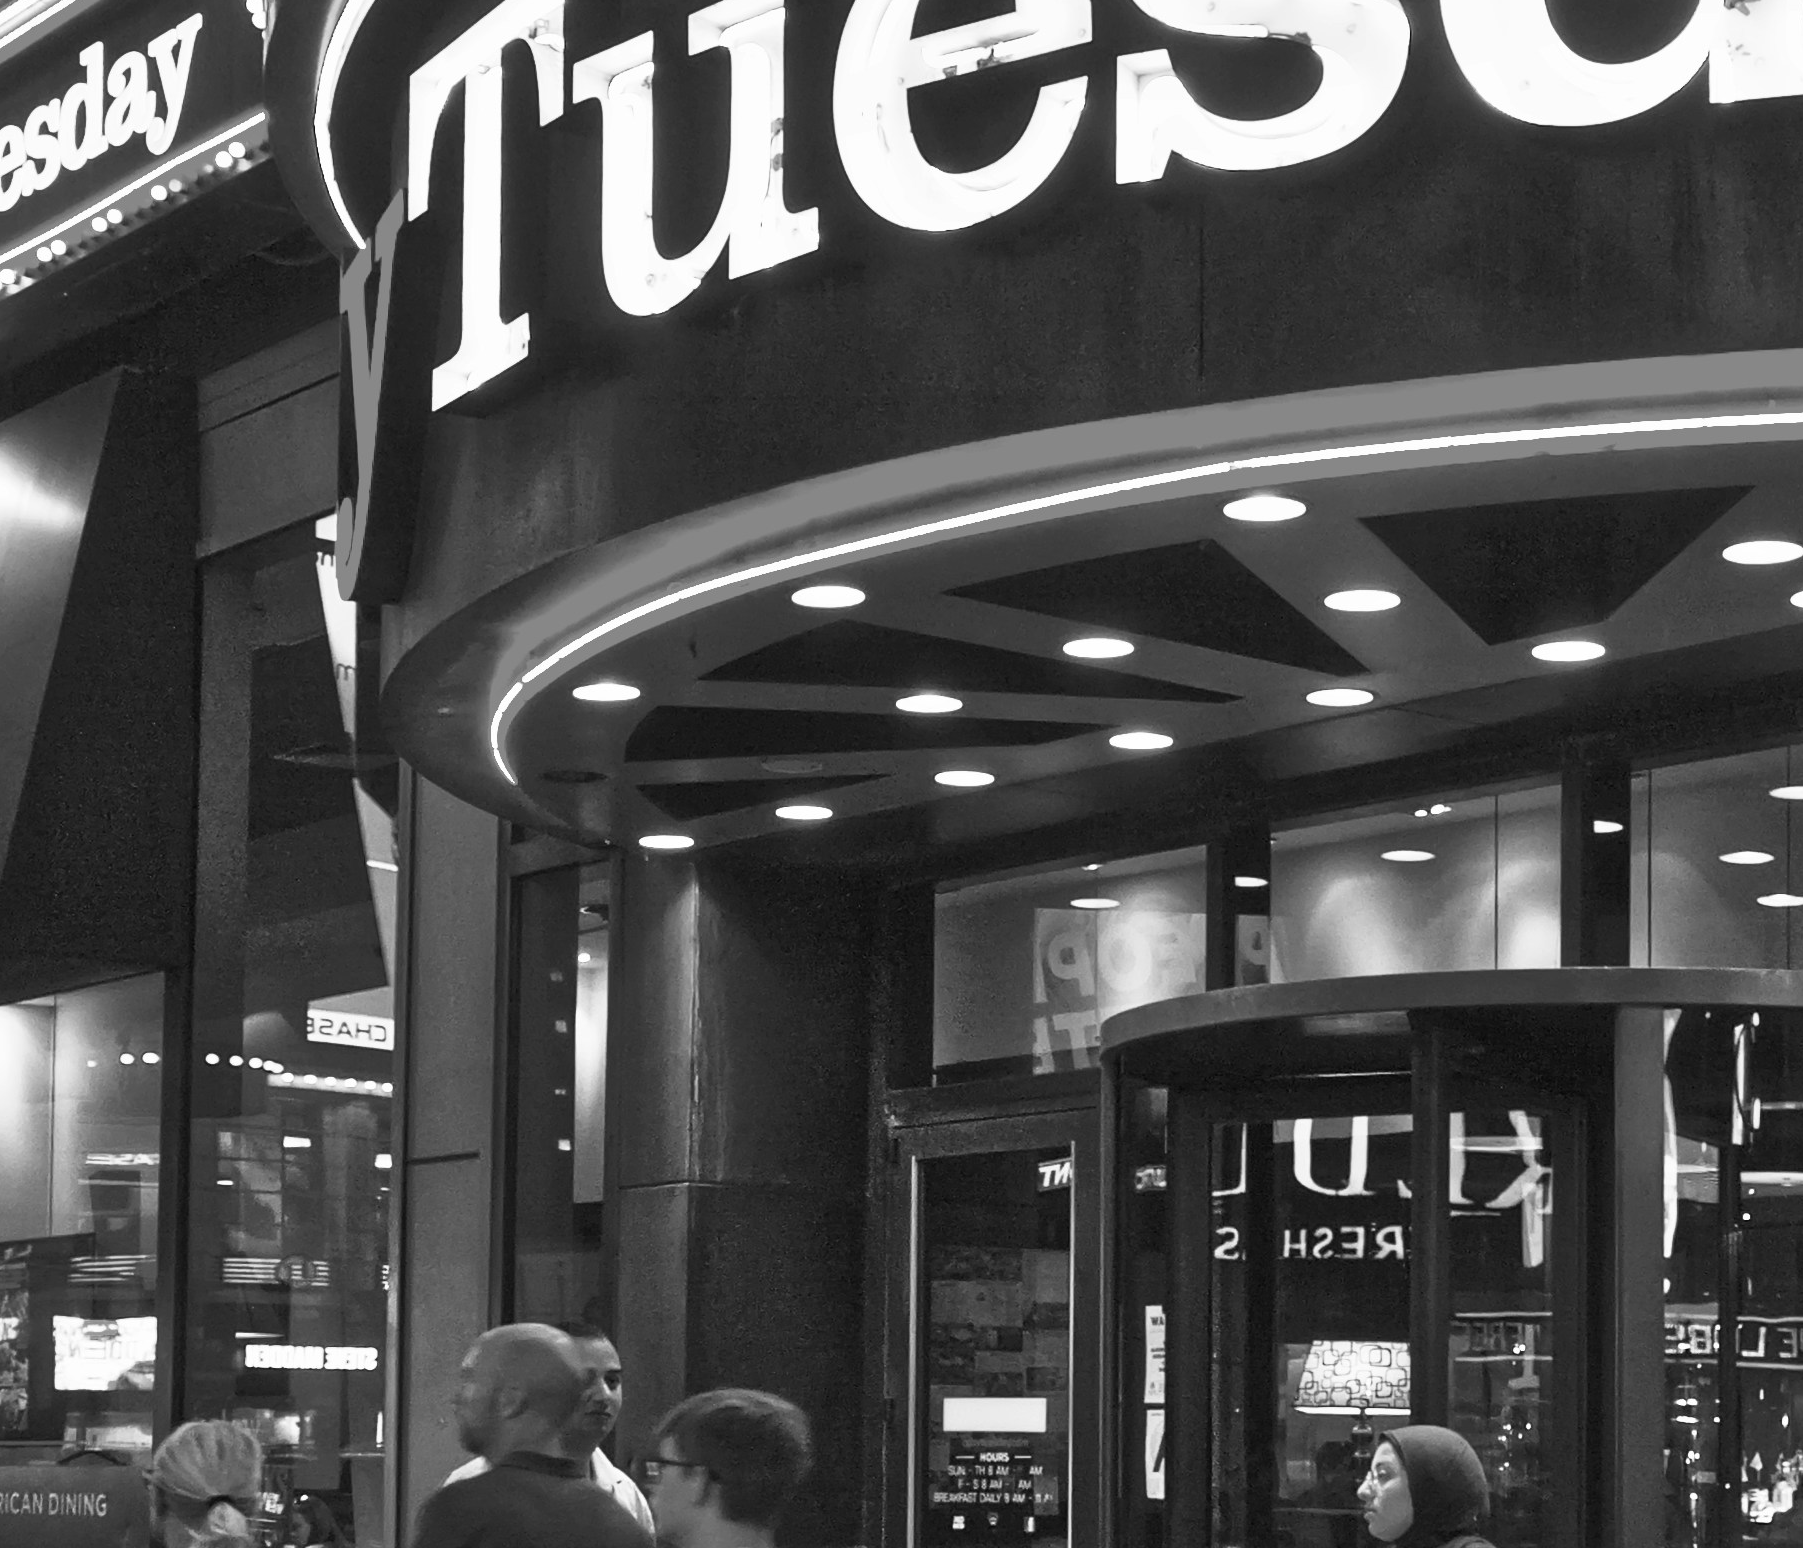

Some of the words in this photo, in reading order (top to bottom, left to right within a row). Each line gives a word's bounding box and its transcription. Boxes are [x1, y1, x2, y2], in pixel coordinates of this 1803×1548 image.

[979, 1452, 1010, 1463] HOURS
[948, 1465, 966, 1476] SUN
[975, 1465, 986, 1475] TH
[996, 1465, 1010, 1475] AM
[1029, 1465, 1044, 1475] AM
[989, 1479, 1003, 1489] AM
[1018, 1479, 1032, 1489] AM
[933, 1493, 977, 1503] BREAKFAST
[979, 1493, 1002, 1503] DAILY
[1012, 1493, 1026, 1503] AM
[47, 1492, 108, 1517] DINING
